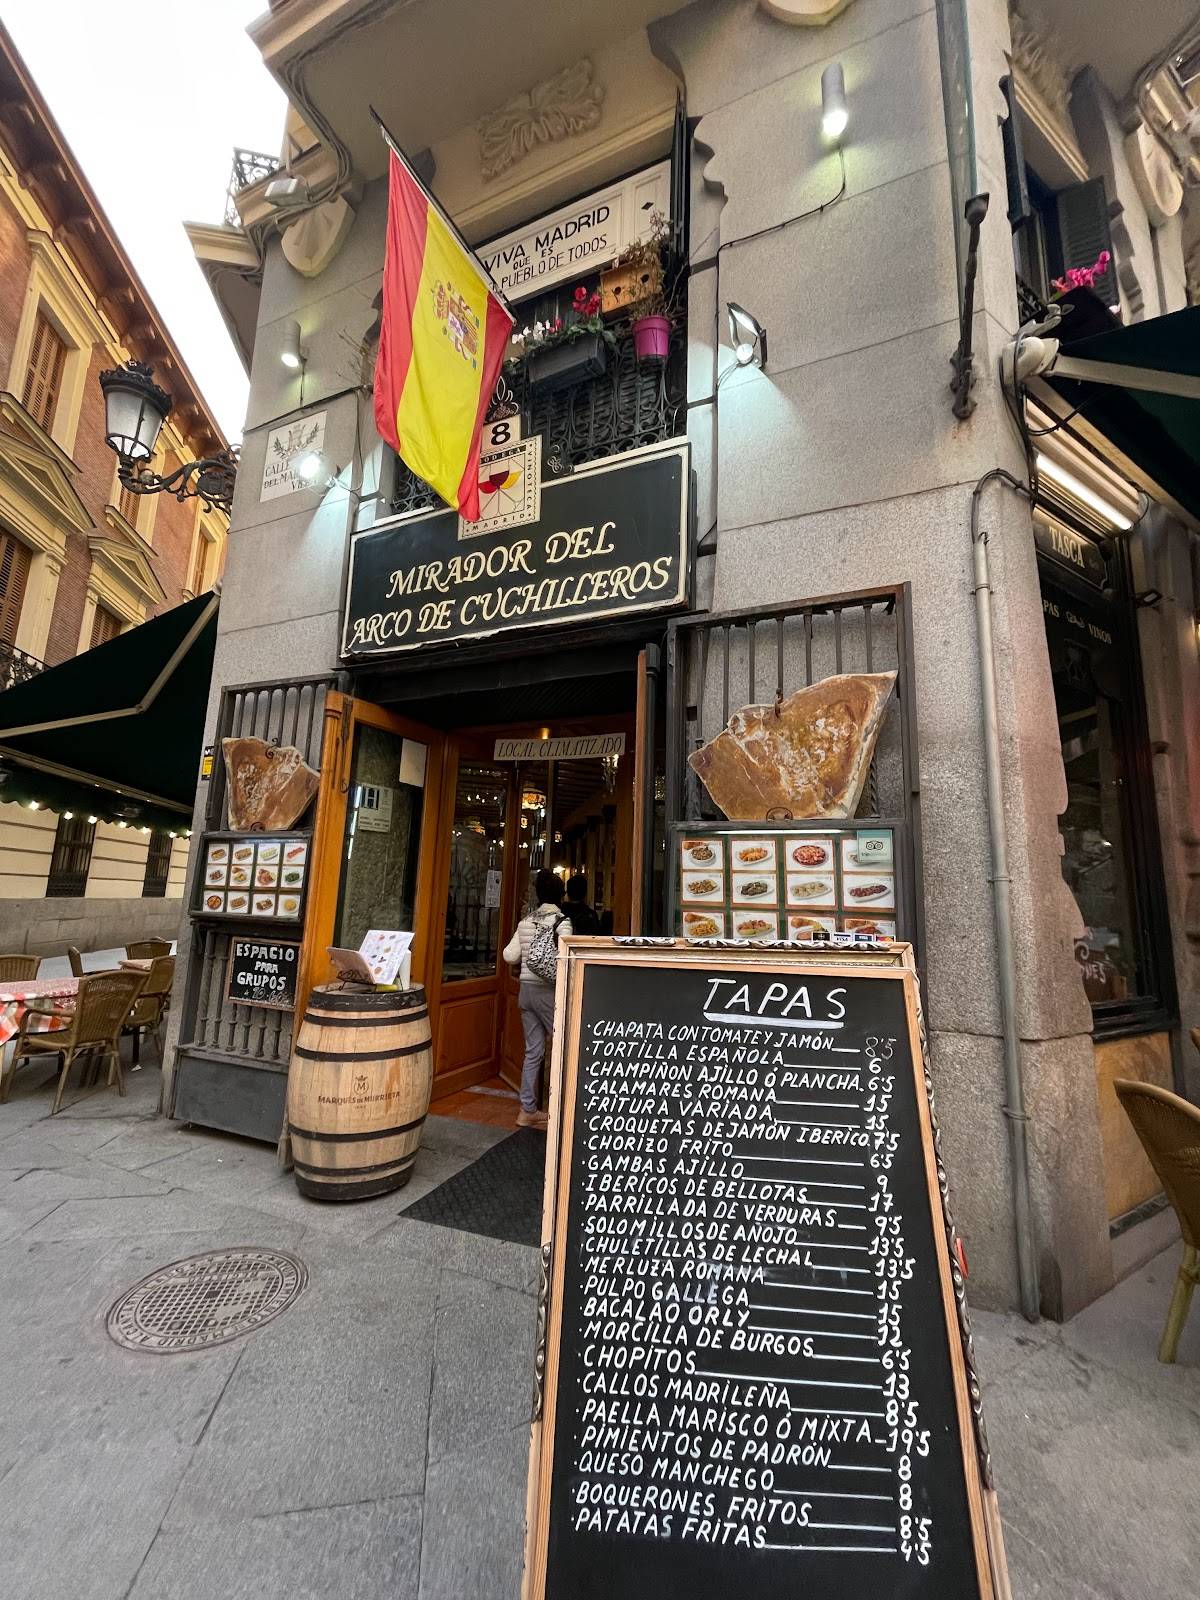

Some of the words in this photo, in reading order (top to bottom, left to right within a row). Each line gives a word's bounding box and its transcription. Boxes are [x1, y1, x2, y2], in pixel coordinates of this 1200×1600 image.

[485, 243, 526, 273] VIVA
[535, 206, 610, 252] MADRID
[513, 255, 531, 271] QUE
[541, 245, 554, 258] ES
[501, 260, 546, 289] PUEBLO
[548, 252, 565, 271] DE
[568, 233, 607, 262] TODOS
[484, 447, 522, 463] ODEGA
[490, 422, 511, 446] 8
[472, 513, 525, 530] MADRID
[385, 539, 537, 599] MIRADOR
[545, 521, 616, 564] DEL
[1048, 526, 1086, 569] TASCA
[347, 608, 413, 649] ARCO
[416, 599, 456, 633] DE
[460, 556, 673, 626] CUCHILLEROS
[1043, 599, 1060, 618] PAS
[498, 742, 536, 758] LOCAL
[540, 736, 621, 758] CLIMATIZADO
[236, 943, 295, 962] ESPACIO
[254, 961, 279, 974] PARA
[237, 971, 287, 991] GRUPOS
[703, 977, 848, 1020] TAPAS
[593, 1020, 663, 1039] CHAPATA
[668, 1025, 700, 1042] CON
[701, 1026, 762, 1045] TOMATE
[774, 1031, 835, 1050] JAMÓN
[589, 1061, 693, 1081] CHAMPIÑON
[697, 1064, 759, 1085] AJILLO
[868, 1076, 896, 1092] 6'5
[592, 1040, 678, 1060] TORTILLA
[686, 1045, 784, 1065] ESPAÑOLA
[869, 1058, 882, 1074] 6
[587, 1094, 669, 1115] FRITURA
[865, 1114, 889, 1130] 15
[588, 1080, 693, 1099] CALAMARES
[698, 1084, 777, 1102] ROMANA
[863, 1094, 892, 1113] 15
[588, 1115, 695, 1136] CROQUETAS
[702, 1121, 724, 1138] DE
[726, 1122, 790, 1141] JAMÓN
[588, 1134, 669, 1153] CHORIZO
[679, 1138, 733, 1157] FRITO
[870, 1153, 894, 1169] 6'5
[585, 1172, 679, 1195] IBERICOS
[684, 1178, 708, 1197] DE
[711, 1180, 808, 1204] BELLOTAS
[868, 1192, 894, 1212] 17
[588, 1154, 667, 1174] GAMBAS
[673, 1156, 744, 1178] AJILLO
[877, 1175, 888, 1193] 9
[585, 1193, 707, 1218] PARRILLADA
[713, 1201, 739, 1219] DE
[744, 1204, 837, 1227] VERDURAS
[875, 1216, 903, 1236] 9'5
[584, 1216, 705, 1240] SOLOMILLOS
[706, 1221, 730, 1241] DE
[868, 1236, 905, 1258] 13'5
[585, 1235, 707, 1259] CHULETILLAS
[712, 1243, 737, 1262] DE
[741, 1245, 813, 1266] LECHAL
[874, 1258, 916, 1280] 13'5
[584, 1256, 675, 1279] MERLUZA
[680, 1260, 764, 1285] ROMANA
[876, 1280, 902, 1300] 15
[584, 1275, 646, 1299] PULPO
[651, 1281, 750, 1307] GALLEGA
[878, 1303, 903, 1326] 15
[583, 1297, 681, 1324] BACALAO
[688, 1305, 750, 1327] ORLY
[878, 1325, 903, 1347] 12
[583, 1320, 688, 1346] MORCILLA
[696, 1327, 724, 1349] DE
[730, 1329, 814, 1357] BURGOS
[881, 1349, 912, 1371] 6'5
[583, 1344, 697, 1375] CHOPITOS
[883, 1371, 910, 1400] 13
[583, 1371, 661, 1398] CALLOS
[664, 1378, 791, 1409] MADRILEÑA
[885, 1399, 919, 1428] 8'5
[582, 1399, 661, 1427] PAELLA
[669, 1404, 768, 1437] MARISCO
[776, 1412, 792, 1439] Ó
[799, 1415, 872, 1443] MIXTA
[886, 1427, 931, 1457] 19'5
[581, 1423, 703, 1459] PIMIENTOS
[709, 1438, 736, 1461] DE
[741, 1440, 832, 1467] PADRÓN
[898, 1455, 912, 1481] 8
[579, 1450, 644, 1476] QUESO
[651, 1457, 775, 1491] MANCHEGO
[899, 1483, 913, 1511] 8
[575, 1507, 674, 1539] PATATAS
[681, 1517, 767, 1549] FRITAS
[576, 1480, 716, 1517] BOQUERONES
[727, 1496, 812, 1527] FRITOS
[900, 1515, 933, 1542] 8'5
